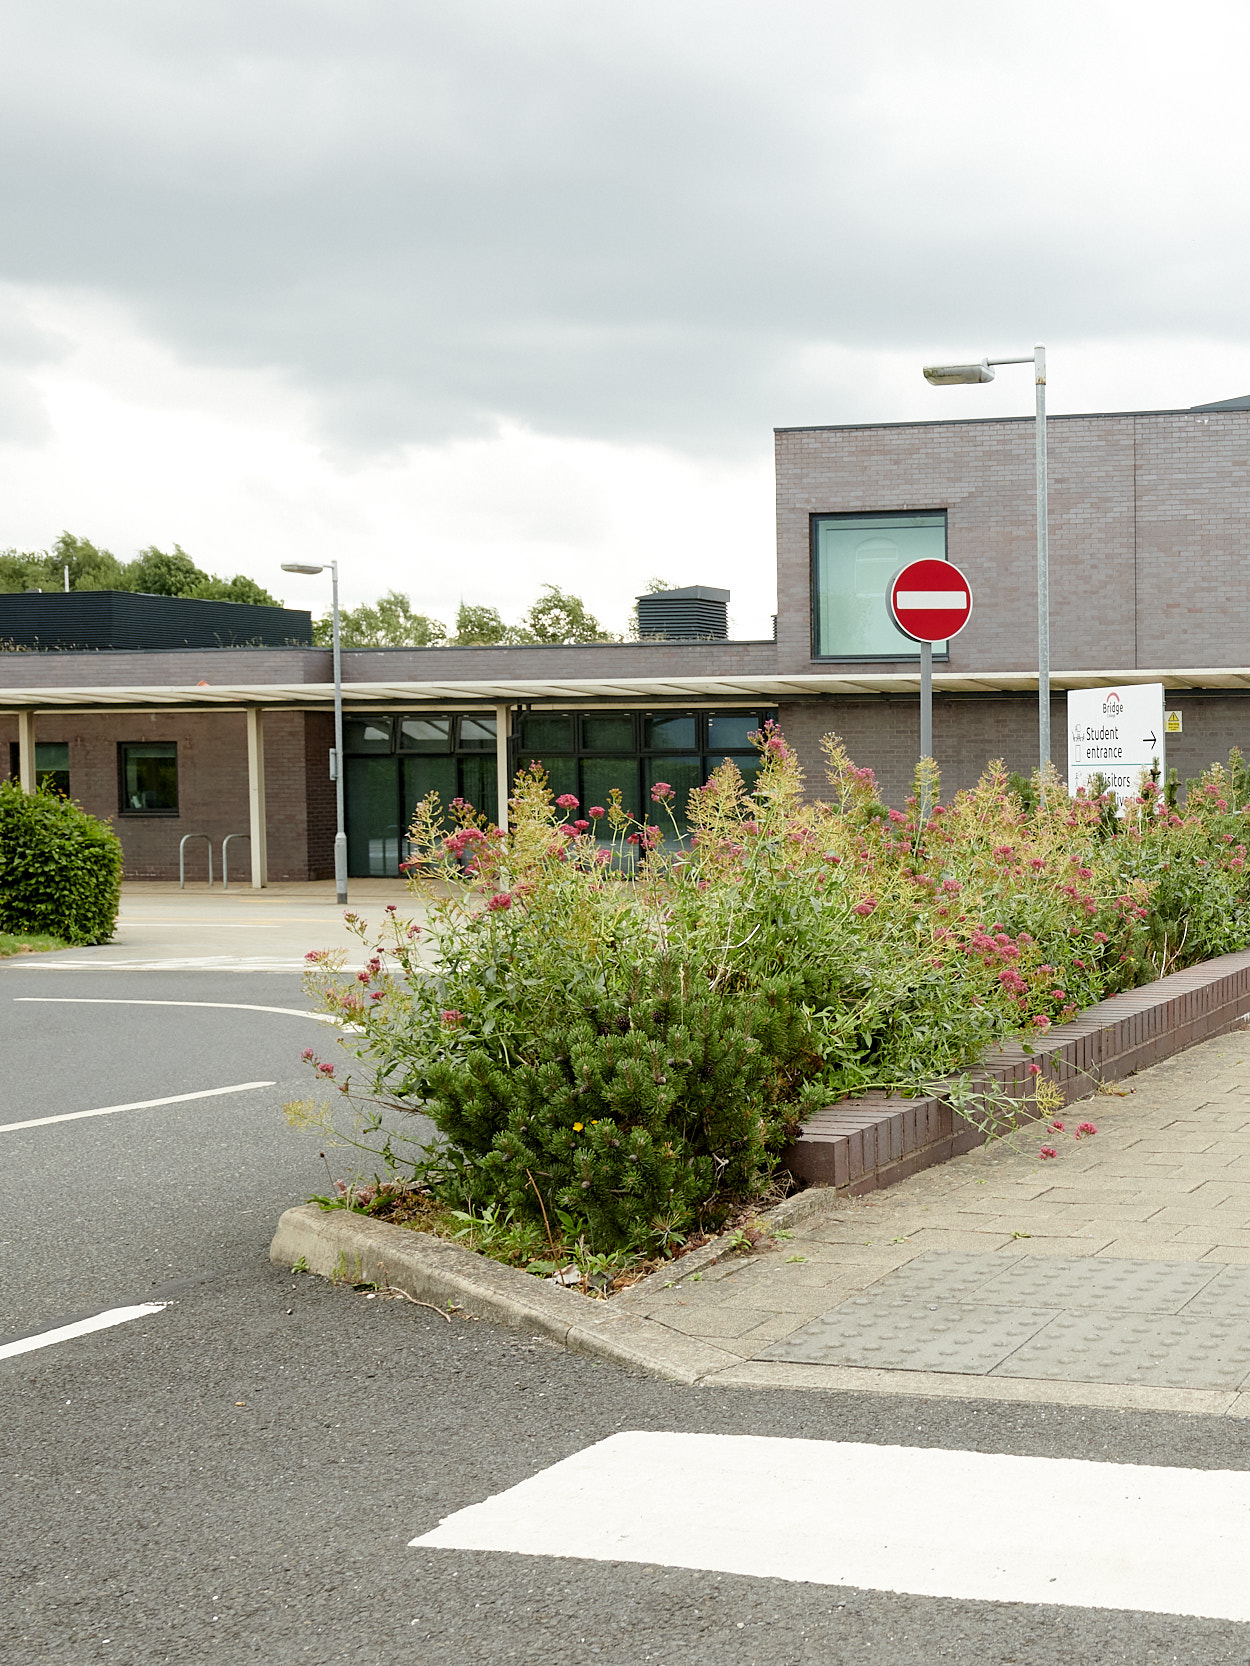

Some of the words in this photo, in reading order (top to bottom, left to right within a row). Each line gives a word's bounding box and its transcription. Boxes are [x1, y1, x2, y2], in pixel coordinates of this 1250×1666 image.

[1102, 702, 1123, 715] Bridge
[1086, 725, 1119, 741] Student
[1086, 745, 1122, 758] entrance
[1102, 772, 1131, 788] isitors
